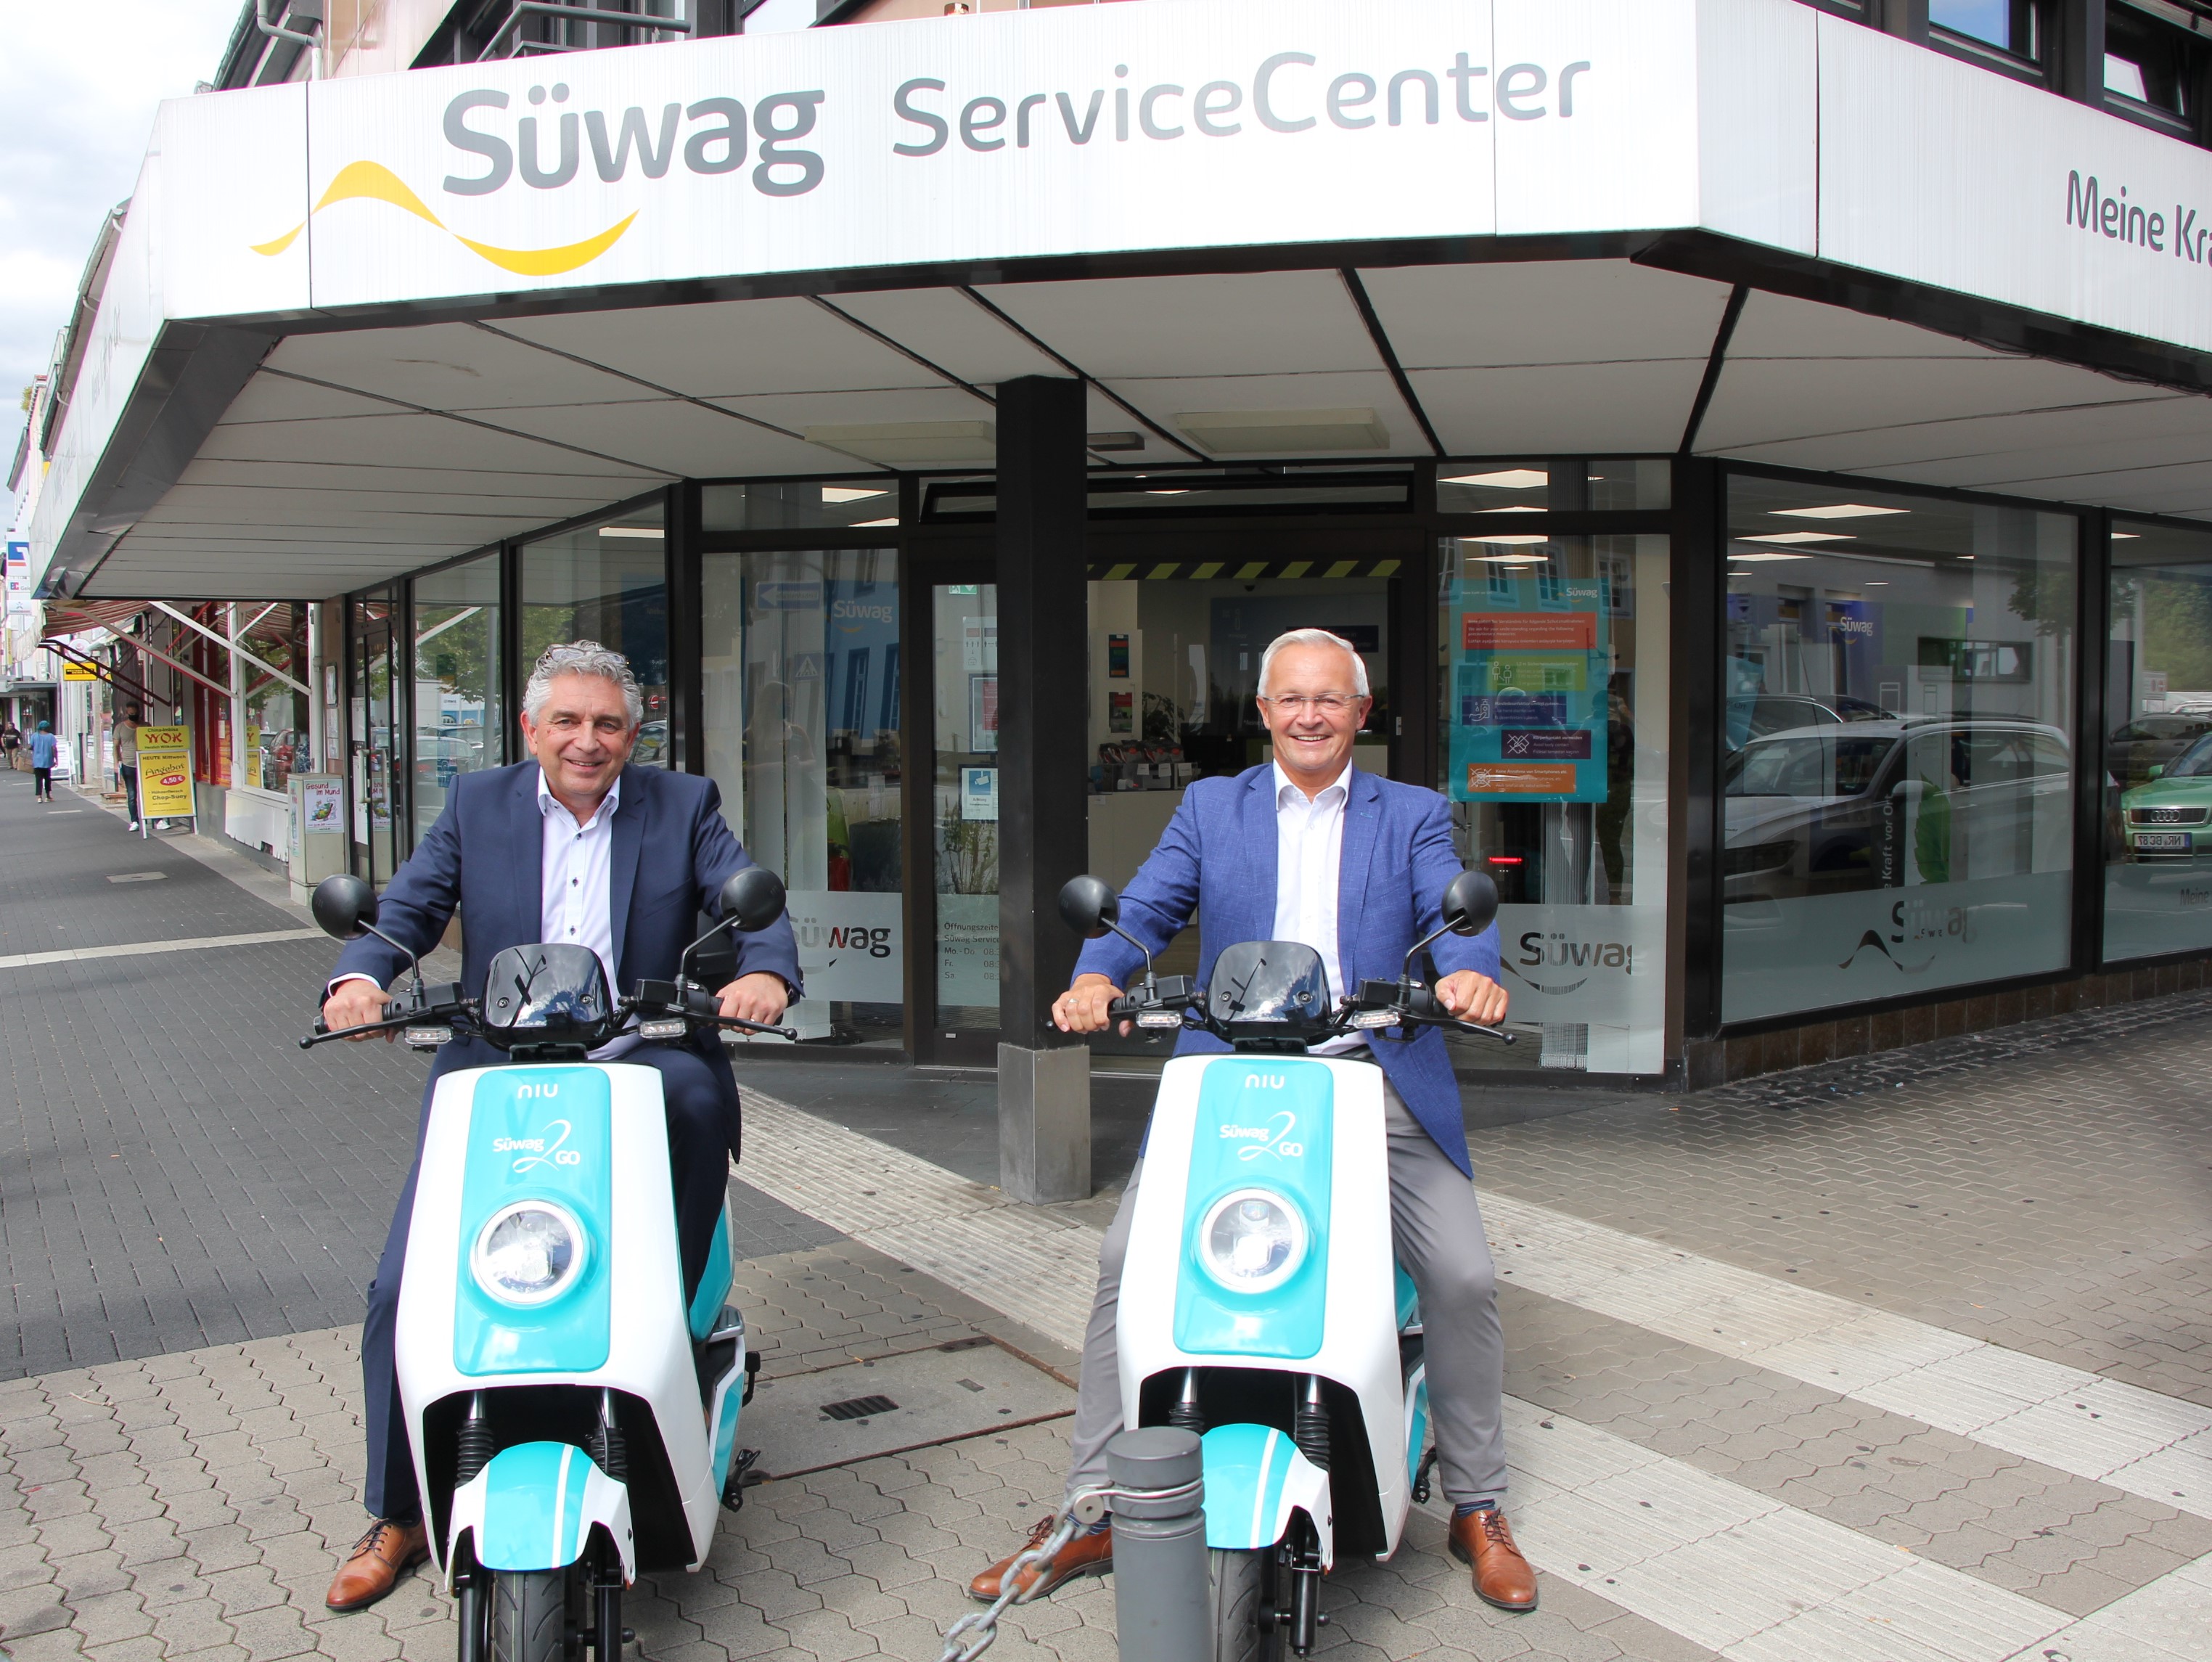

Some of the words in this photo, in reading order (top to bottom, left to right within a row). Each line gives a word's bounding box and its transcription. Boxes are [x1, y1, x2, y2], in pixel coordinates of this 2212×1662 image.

[442, 82, 826, 197] Süwag
[892, 51, 1592, 157] ServiceCenter
[2066, 170, 2165, 252] Meine
[1565, 587, 1597, 598] Süwag
[833, 599, 893, 623] Süwag
[1840, 616, 1873, 636] Süwag
[144, 732, 183, 743] WOK
[145, 764, 184, 776] Angebot
[1884, 794, 1893, 816] Ort
[1883, 846, 1893, 880] Kraft
[2180, 888, 2210, 906] Meine
[944, 921, 999, 932] Öffnungszeite
[944, 934, 970, 944] Süwag
[1519, 931, 1647, 977] Süwag
[492, 1137, 545, 1153] Süwag
[554, 1150, 581, 1166] GO
[1218, 1124, 1270, 1142] Süwag
[1278, 1141, 1303, 1157] GO
